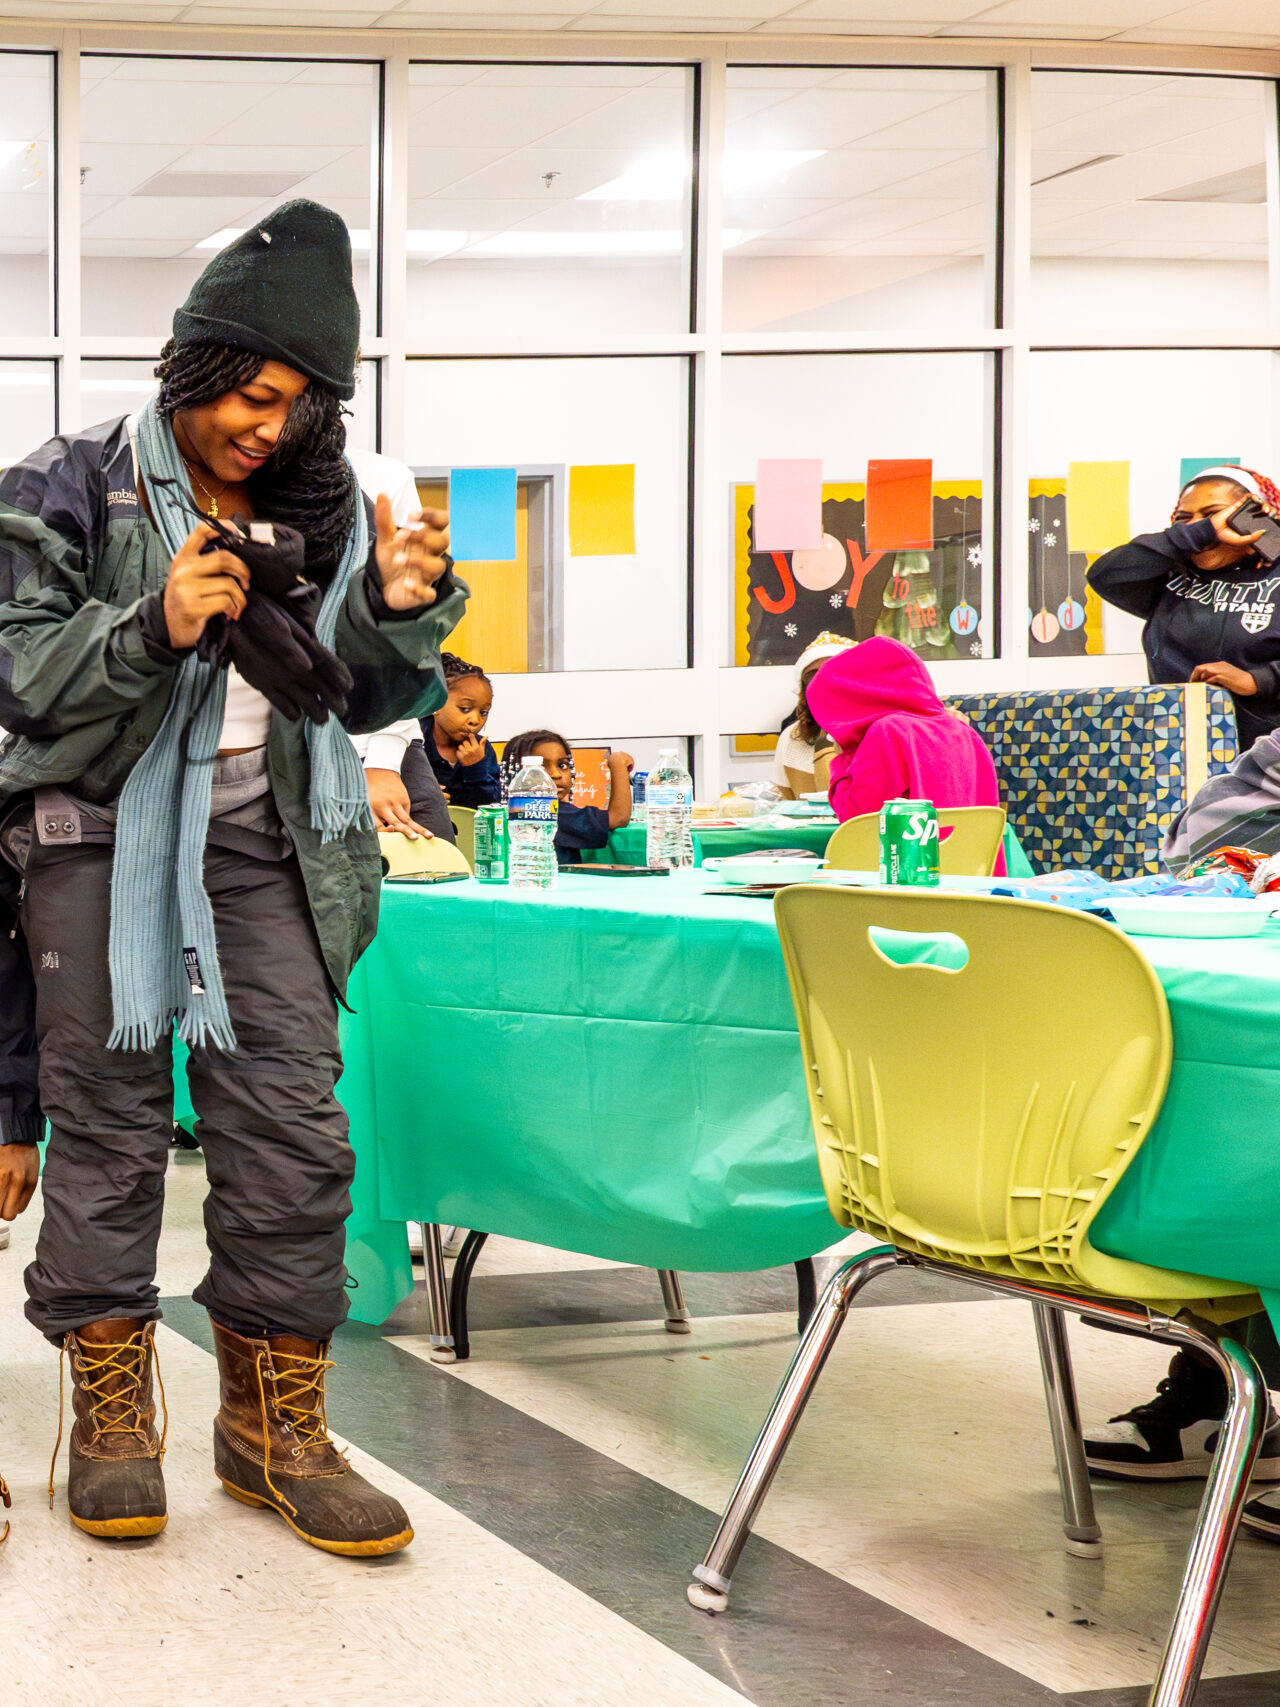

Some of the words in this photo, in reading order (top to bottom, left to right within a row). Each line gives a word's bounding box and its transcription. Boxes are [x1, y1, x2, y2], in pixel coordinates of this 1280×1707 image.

[752, 532, 887, 615] JOY
[893, 573, 910, 600] to
[1166, 574, 1280, 605] INITY
[905, 602, 937, 630] the
[1213, 602, 1276, 613] TITANS
[524, 803, 551, 811] DEER
[524, 811, 552, 820] PARK
[901, 811, 938, 846] Sp
